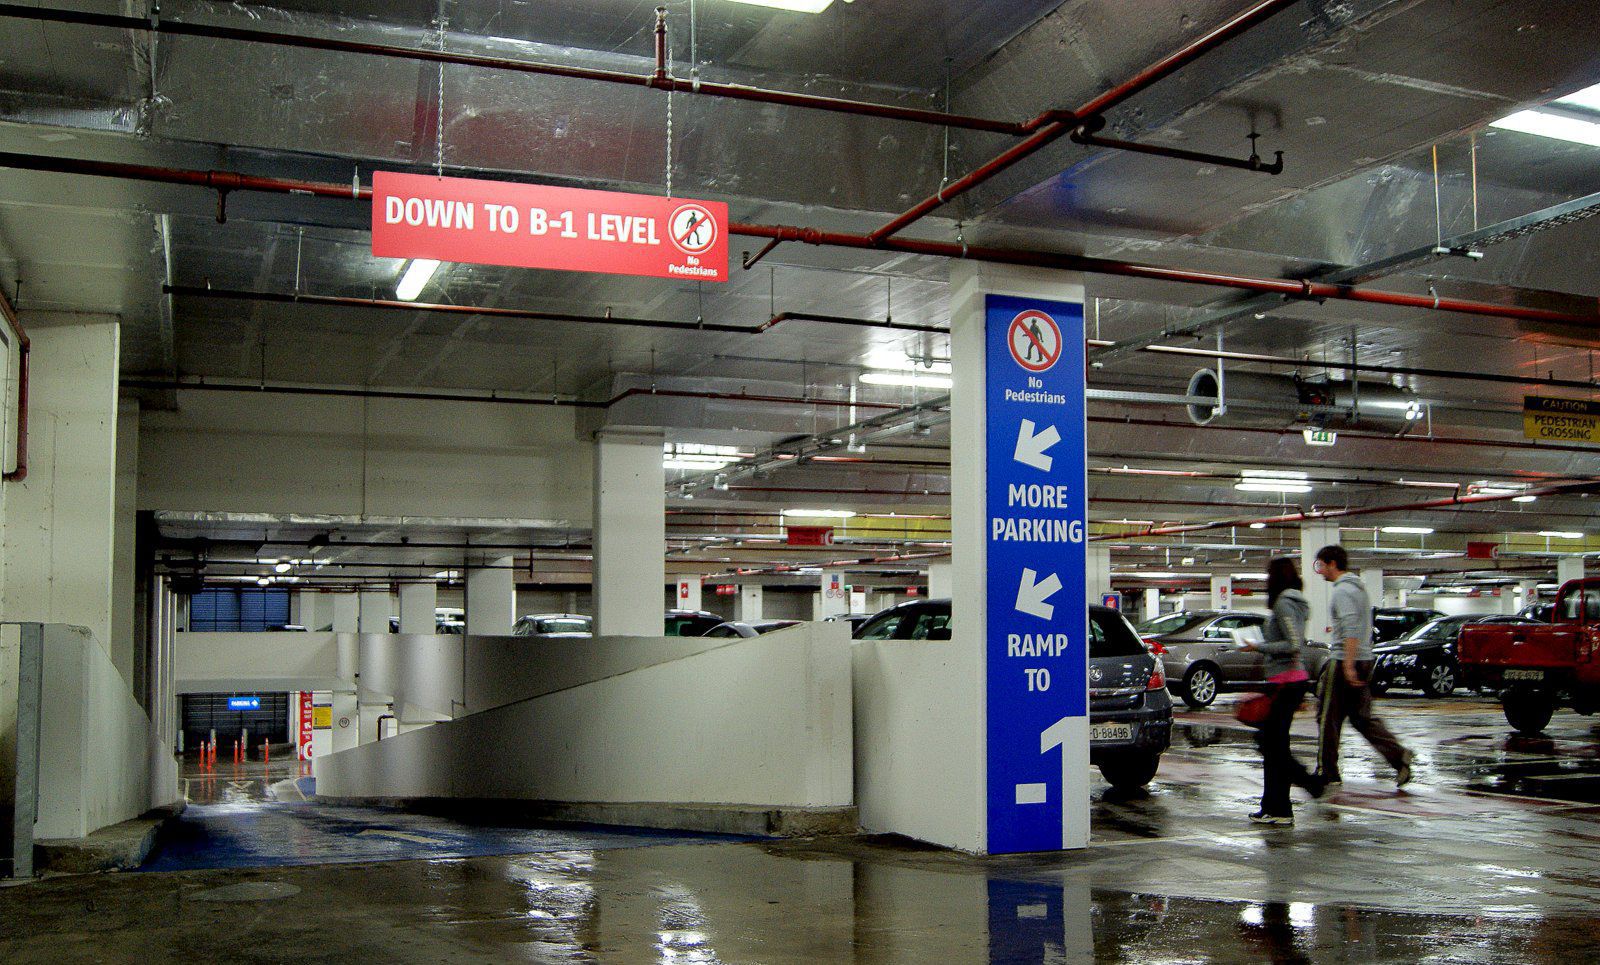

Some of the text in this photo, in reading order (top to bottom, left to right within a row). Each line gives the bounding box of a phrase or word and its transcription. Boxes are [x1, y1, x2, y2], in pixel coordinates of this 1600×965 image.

[385, 196, 661, 245] DOWN TO B-1 LEVEL
[686, 255, 700, 266] No
[668, 263, 718, 277] Pedestrians
[1028, 376, 1043, 389] No
[1005, 388, 1066, 405] Pedestrians
[1542, 399, 1587, 411] CAUTION
[1535, 414, 1595, 429] PEDESTRIAN
[1541, 427, 1590, 439] CROSSING
[1008, 483, 1068, 508] MORE
[992, 517, 1083, 543] PARKING
[1007, 633, 1069, 657] RAMP
[1024, 668, 1051, 692] TO
